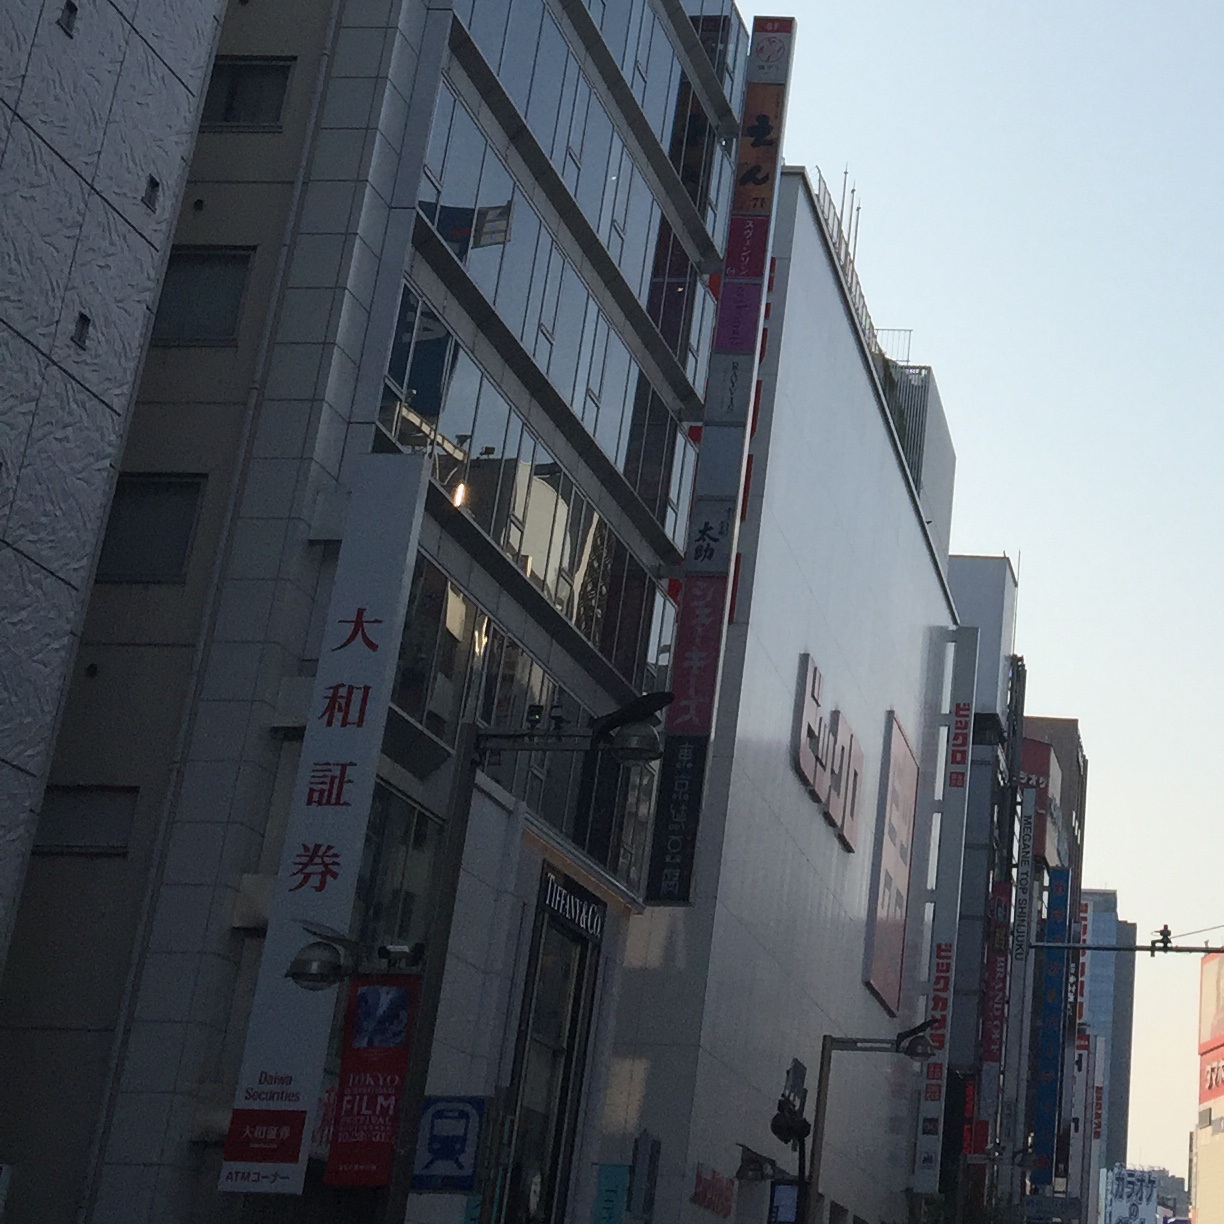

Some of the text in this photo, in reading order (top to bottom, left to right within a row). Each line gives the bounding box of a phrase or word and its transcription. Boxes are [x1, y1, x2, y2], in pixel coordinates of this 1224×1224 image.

[693, 522, 719, 563] 太助
[288, 607, 383, 893] 大和証券
[1015, 816, 1033, 962] MEGANE TOP SHINJUKU
[258, 1070, 293, 1086] Daiwa
[347, 1073, 401, 1087] TOKYO
[244, 1088, 301, 1102] Securities
[341, 1095, 396, 1116] FILM
[226, 1171, 290, 1184] ATMコーナー
[1113, 1172, 1157, 1205] カラオケ
